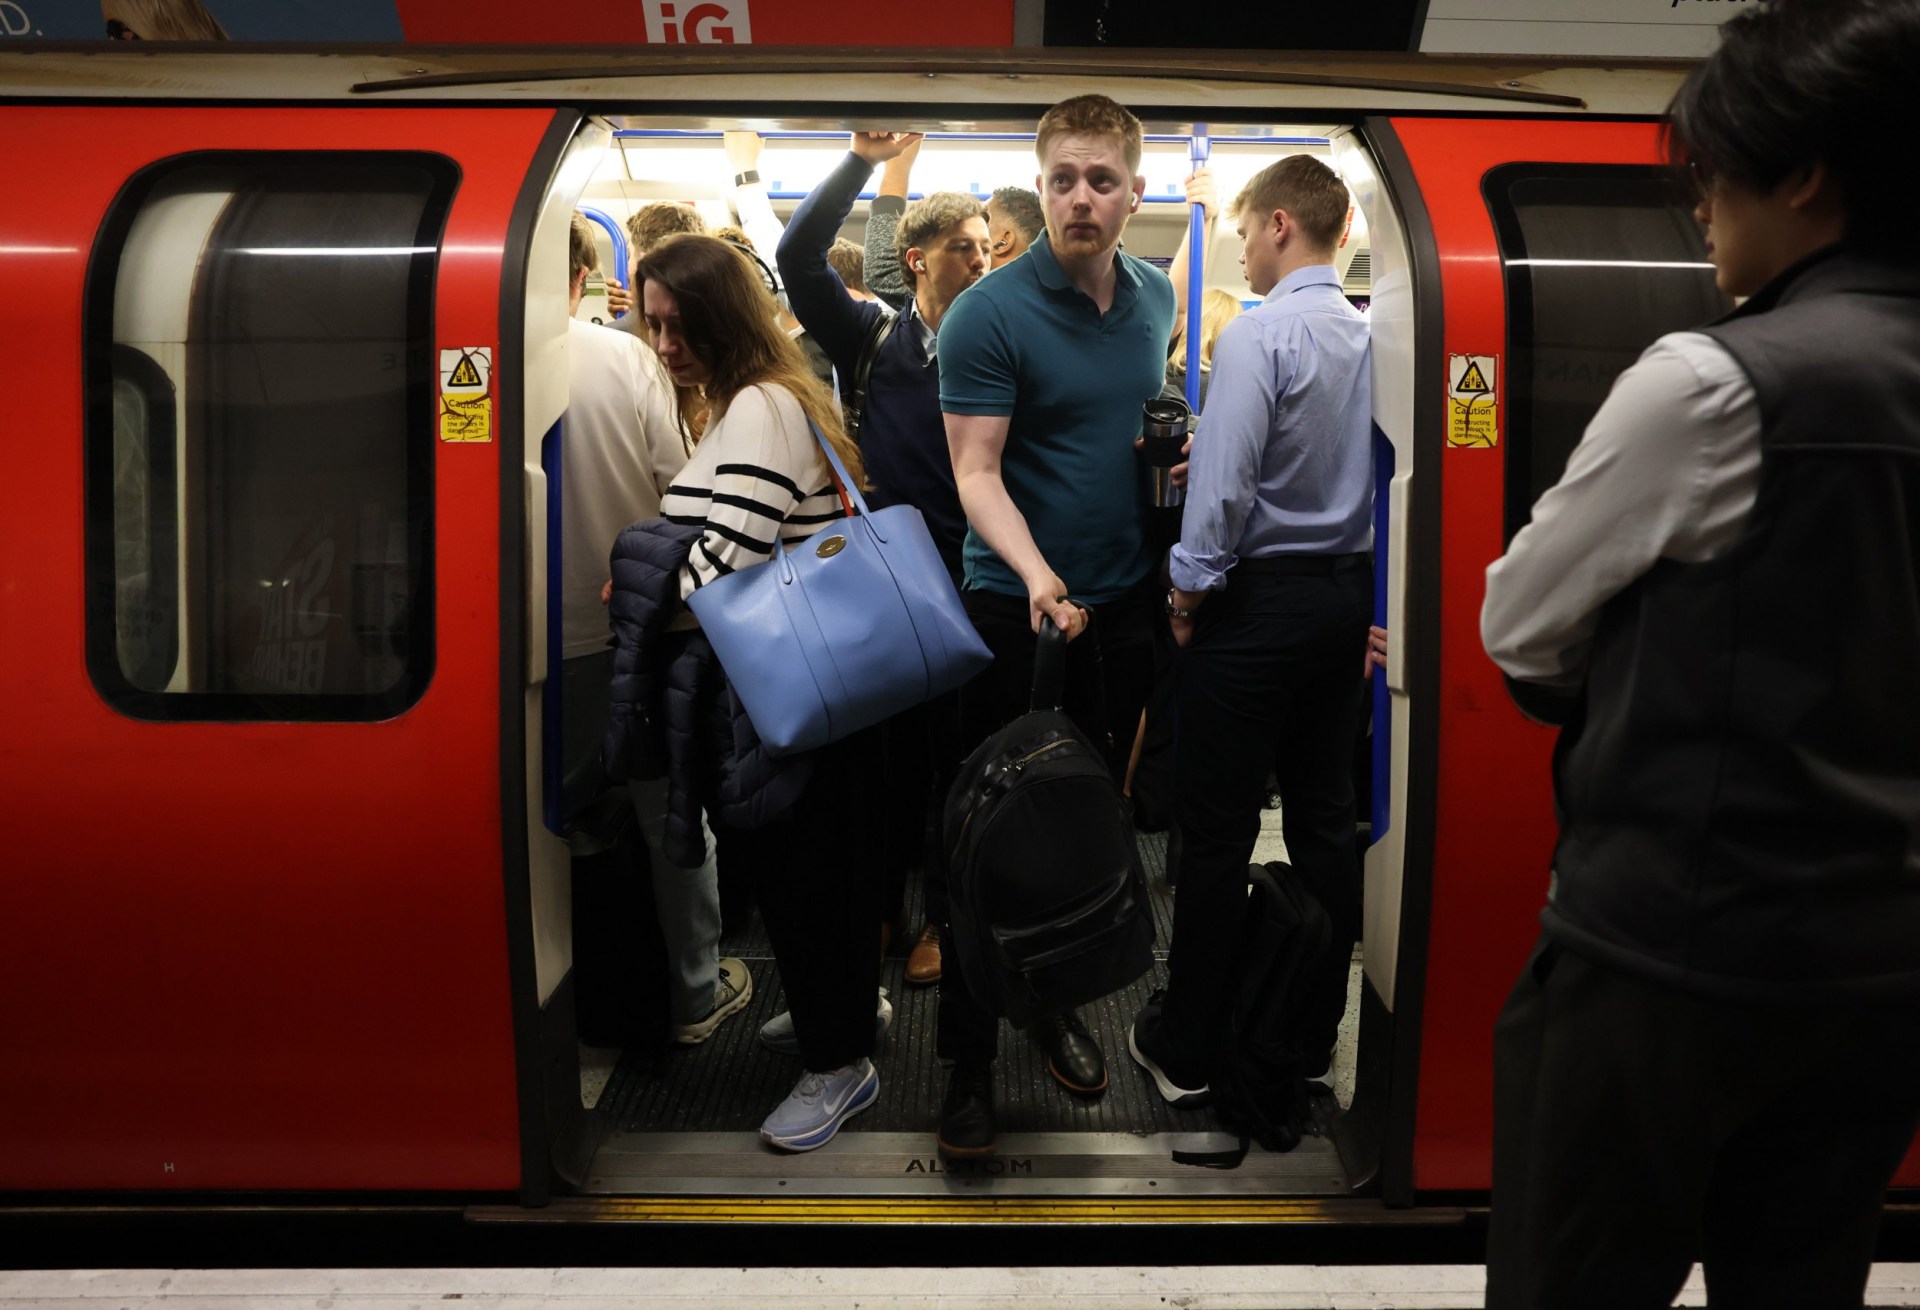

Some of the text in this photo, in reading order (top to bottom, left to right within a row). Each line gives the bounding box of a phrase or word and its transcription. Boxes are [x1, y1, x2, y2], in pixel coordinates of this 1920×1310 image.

[0, 0, 43, 36] D.
[448, 399, 485, 409] Caution
[1454, 406, 1491, 415] Caution
[164, 1162, 175, 1173] H
[905, 1159, 1032, 1174] ALSTOM
